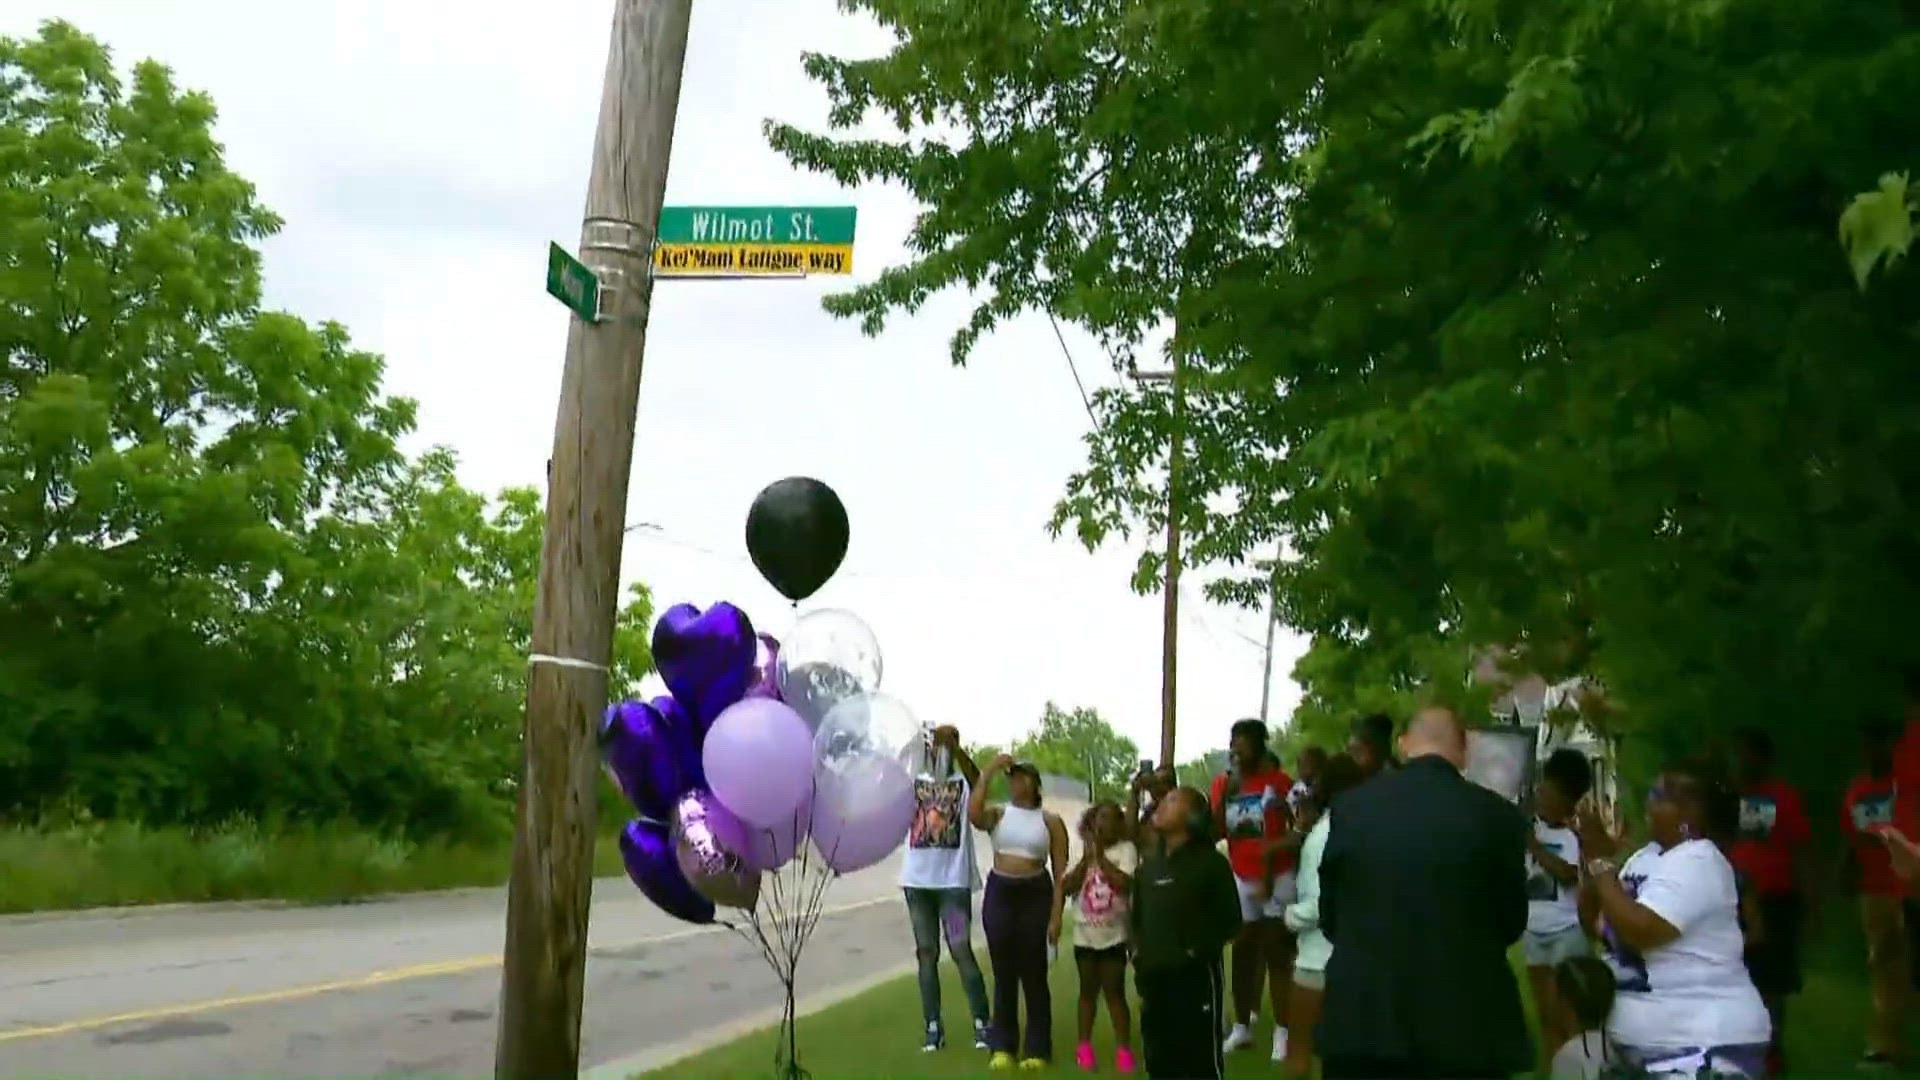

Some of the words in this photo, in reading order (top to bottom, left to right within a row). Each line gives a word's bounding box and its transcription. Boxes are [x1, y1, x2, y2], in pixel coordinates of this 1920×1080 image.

[692, 211, 773, 242] Wilmot
[789, 211, 819, 242] St.
[809, 252, 845, 273] way
